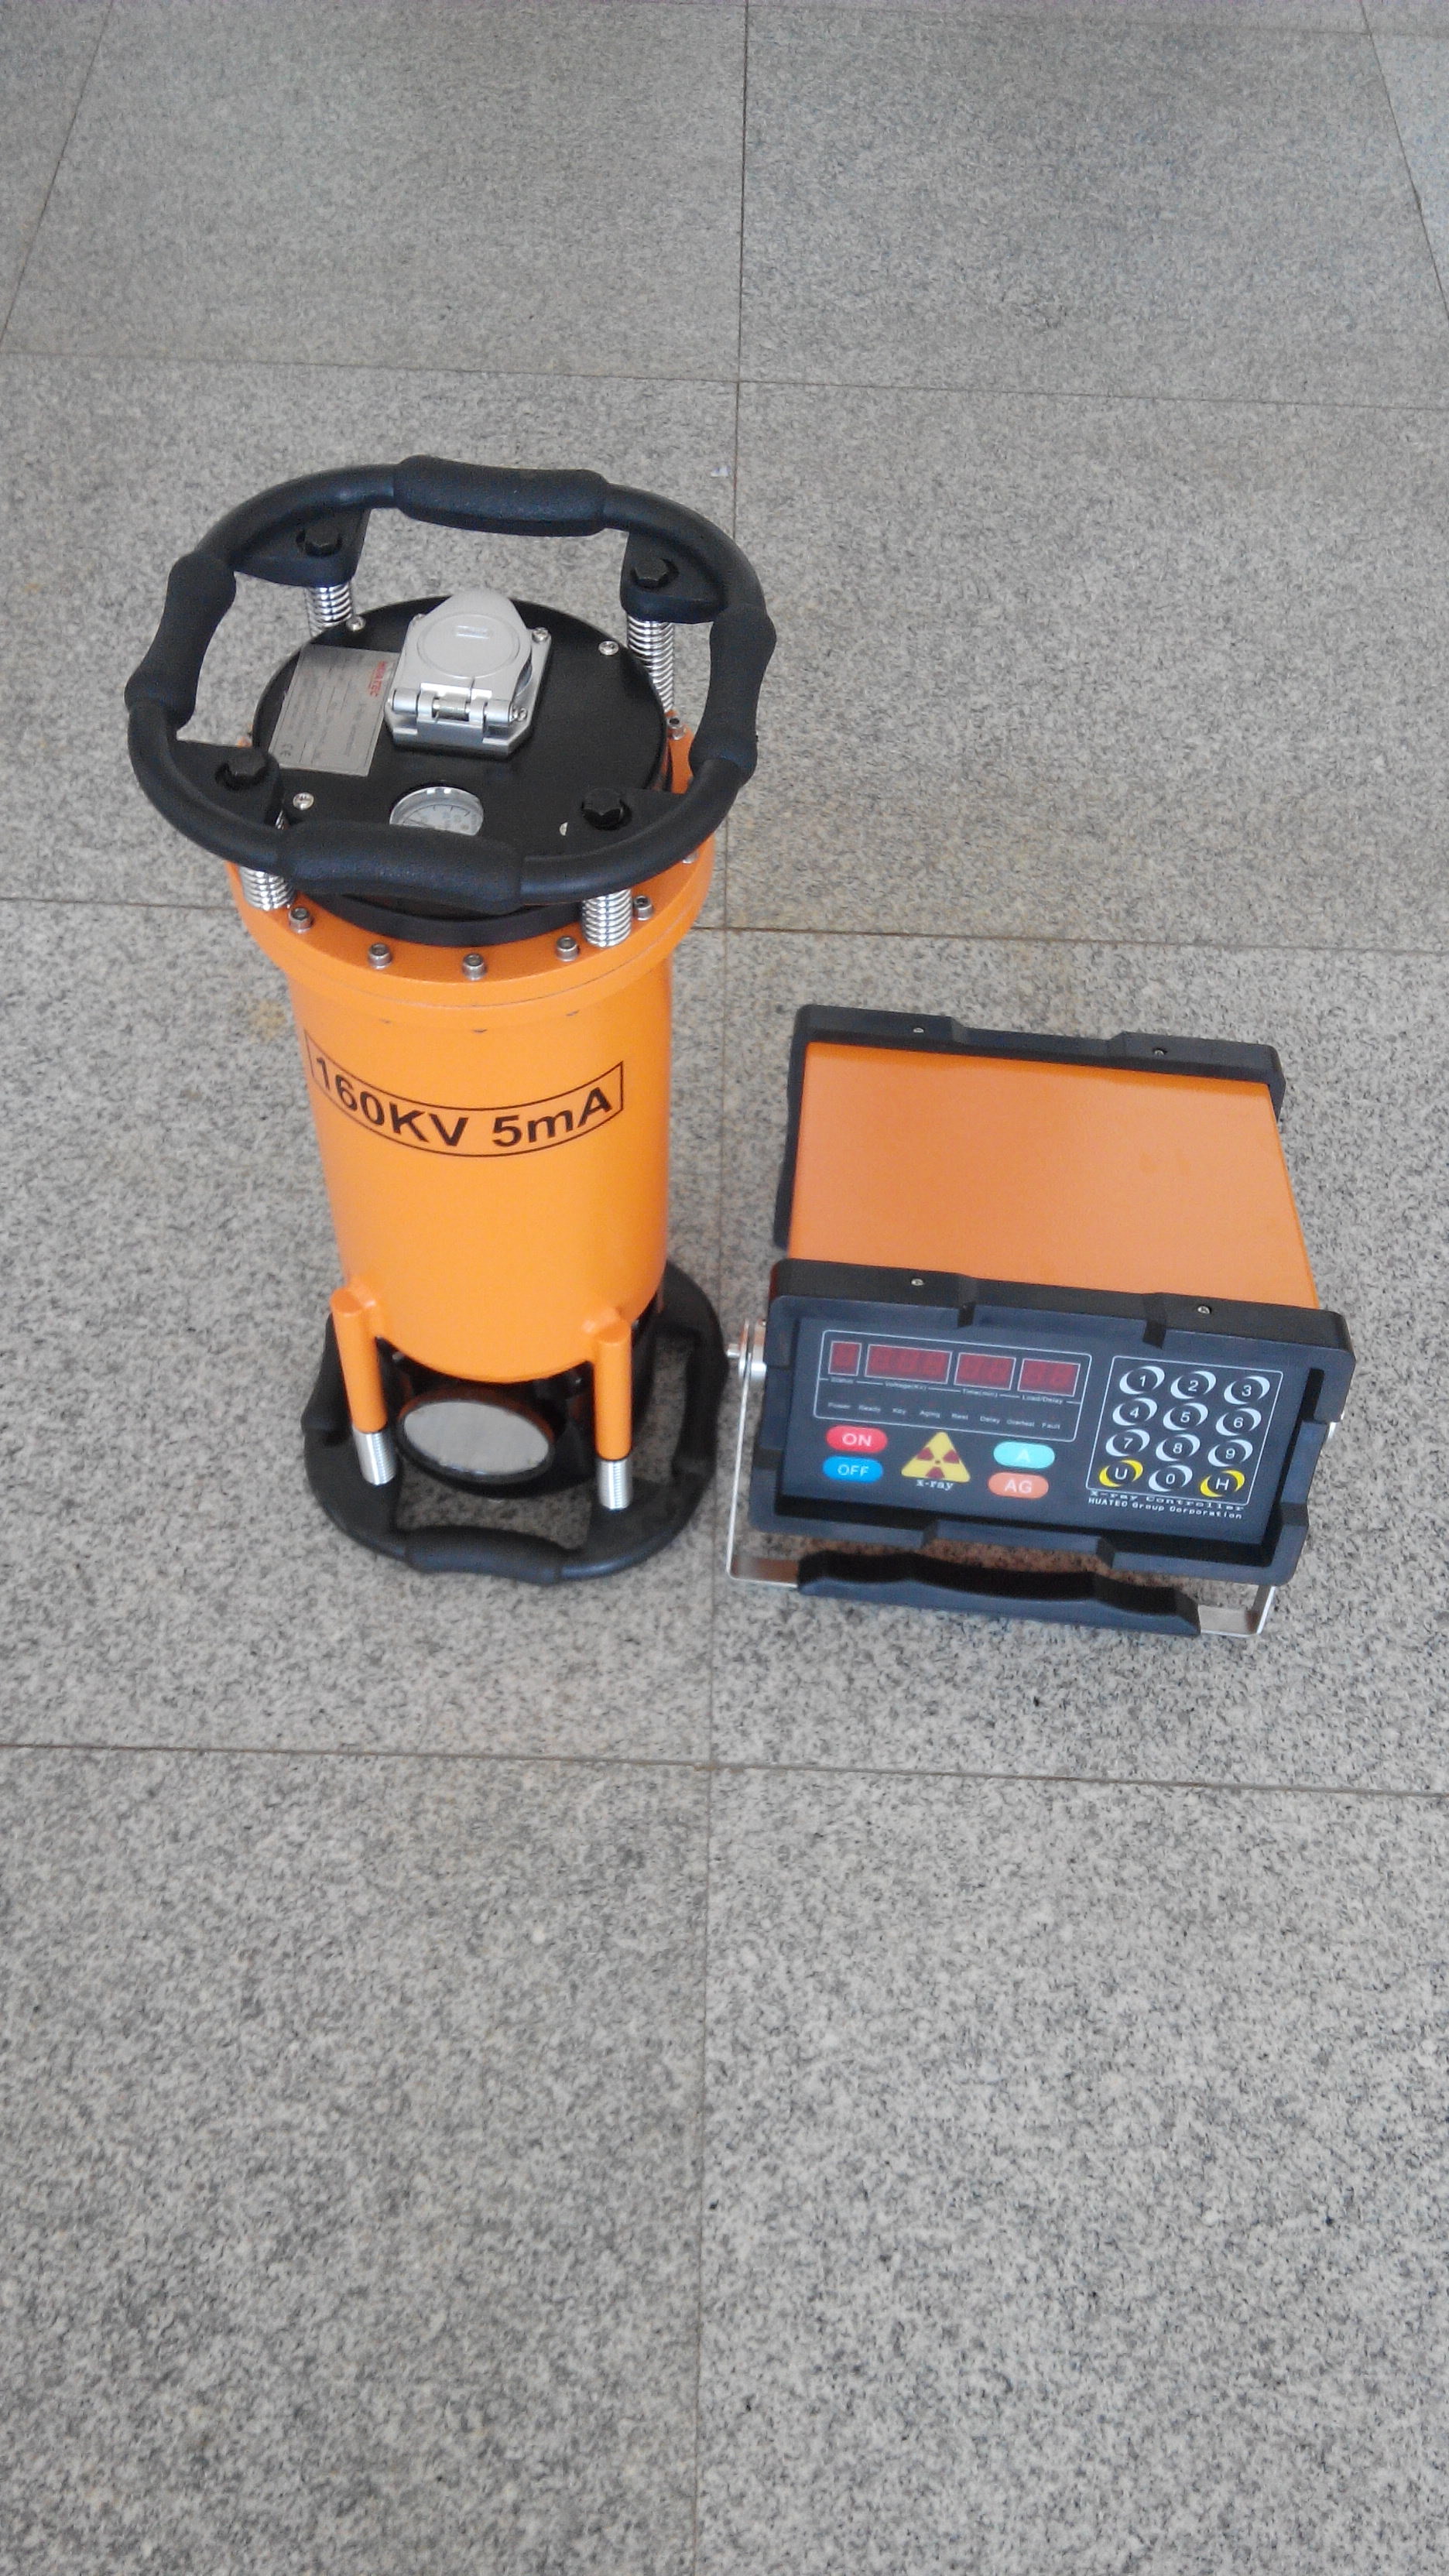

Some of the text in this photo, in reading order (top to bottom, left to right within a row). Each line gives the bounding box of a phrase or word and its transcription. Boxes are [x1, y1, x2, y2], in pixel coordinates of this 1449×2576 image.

[315, 1057, 612, 1147] 160KV 5mA
[1139, 1375, 1147, 1388] 1
[1187, 1379, 1199, 1392] 2
[1241, 1385, 1252, 1397] 3
[1129, 1406, 1139, 1419] 4
[1180, 1411, 1190, 1423] 5
[1041, 1422, 1061, 1430] Fault
[1233, 1416, 1244, 1429] 6
[841, 1432, 873, 1447] ON
[1122, 1437, 1134, 1450] 7
[1172, 1443, 1184, 1454] 8
[1225, 1448, 1235, 1460] 9
[1014, 1449, 1031, 1463] A
[837, 1464, 870, 1478] OFF
[1114, 1468, 1129, 1481] U
[1003, 1481, 1033, 1495] AG
[1214, 1478, 1230, 1492] H
[1146, 1495, 1245, 1512] Controller
[1132, 1502, 1165, 1512] Group
[1170, 1506, 1243, 1520] Corporation
